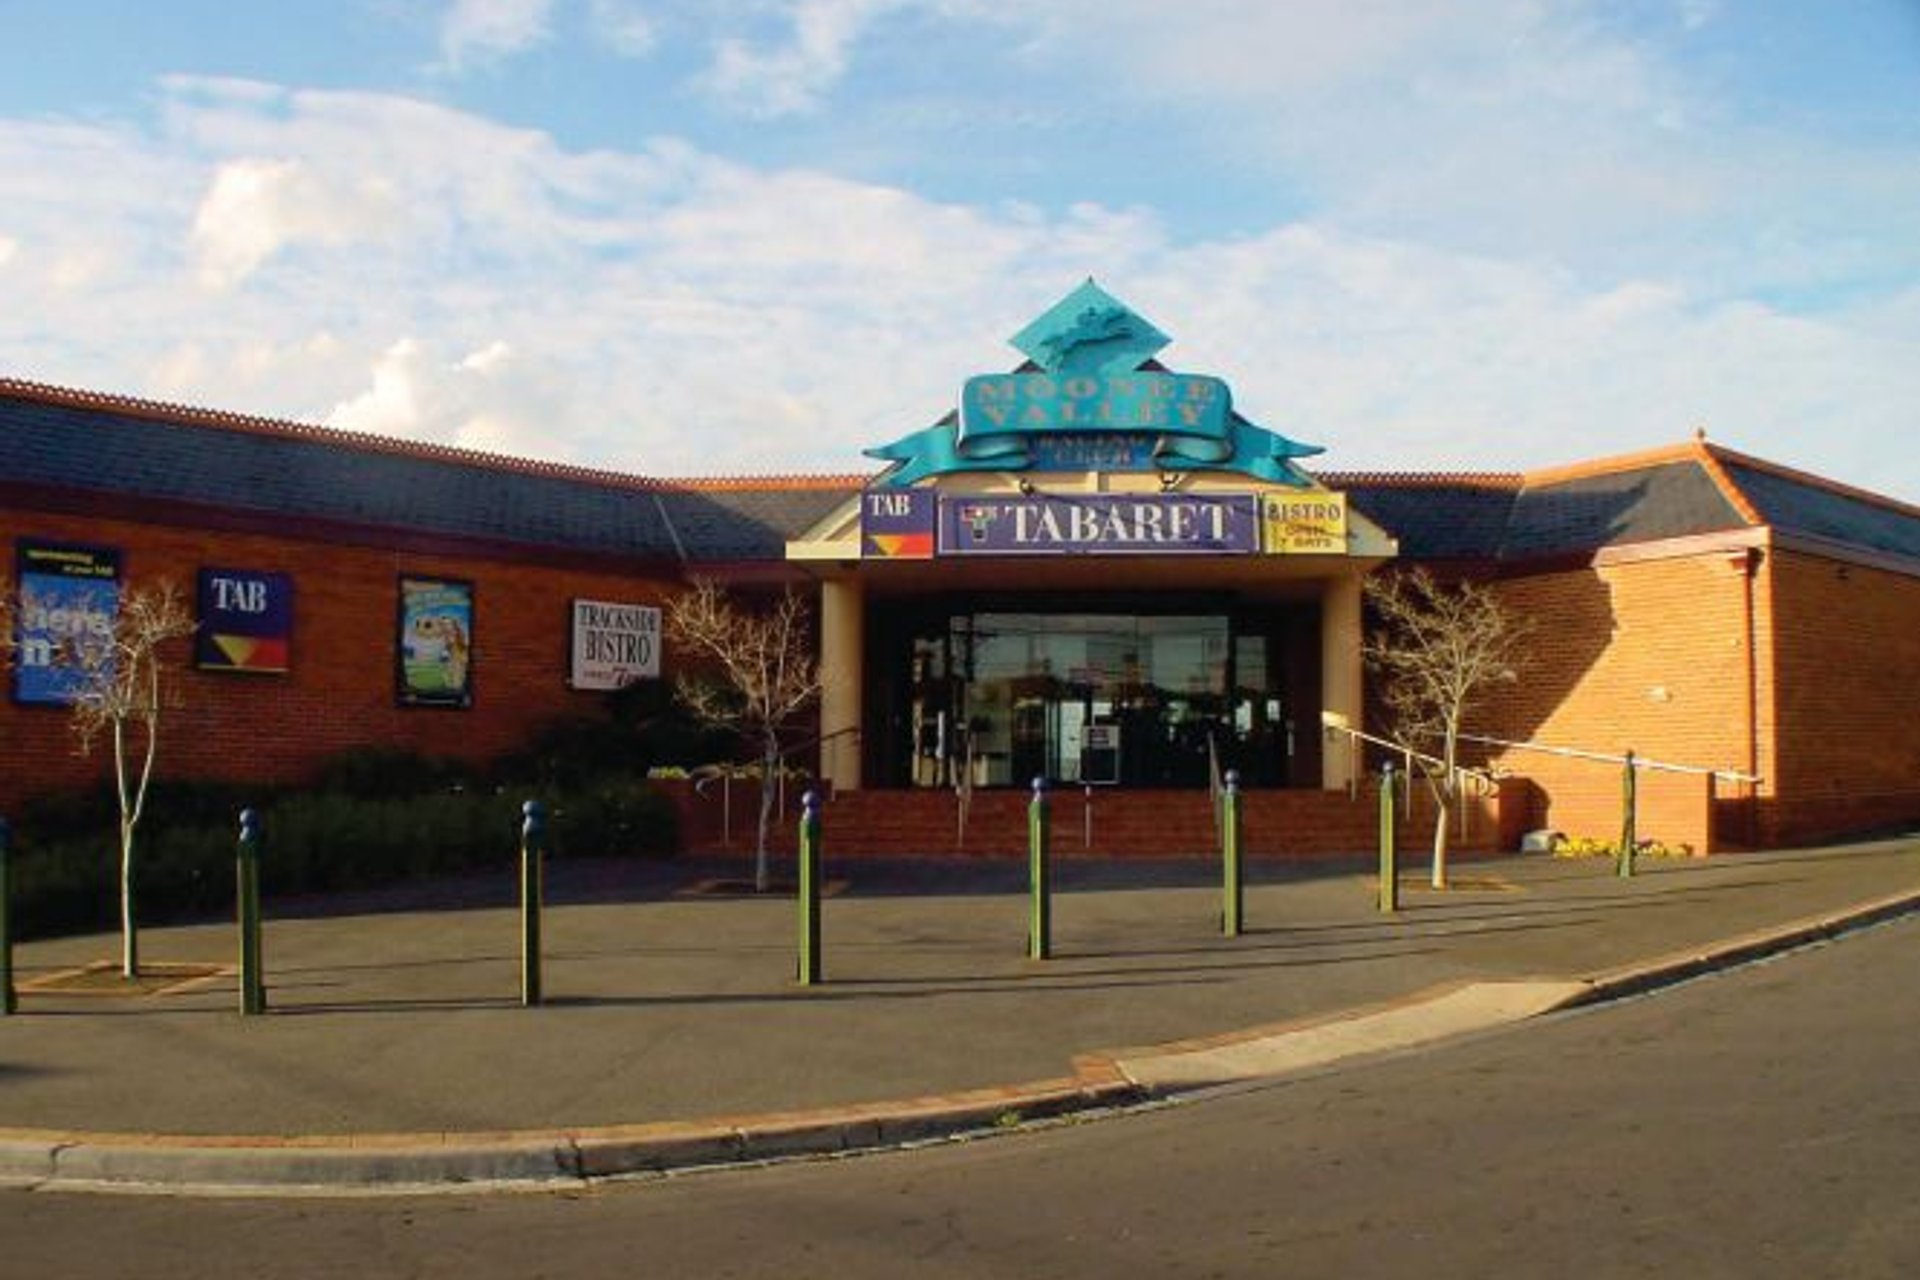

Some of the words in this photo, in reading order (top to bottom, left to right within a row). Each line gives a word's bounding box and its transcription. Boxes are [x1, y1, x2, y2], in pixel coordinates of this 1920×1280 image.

[978, 376, 1217, 404] MOONEE
[980, 401, 1208, 428] VALLEY
[867, 494, 911, 517] TAB
[1267, 502, 1341, 521] BISTRO
[1004, 503, 1235, 543] TABARET
[210, 577, 267, 614] TAB
[585, 629, 652, 667] BISTRO
